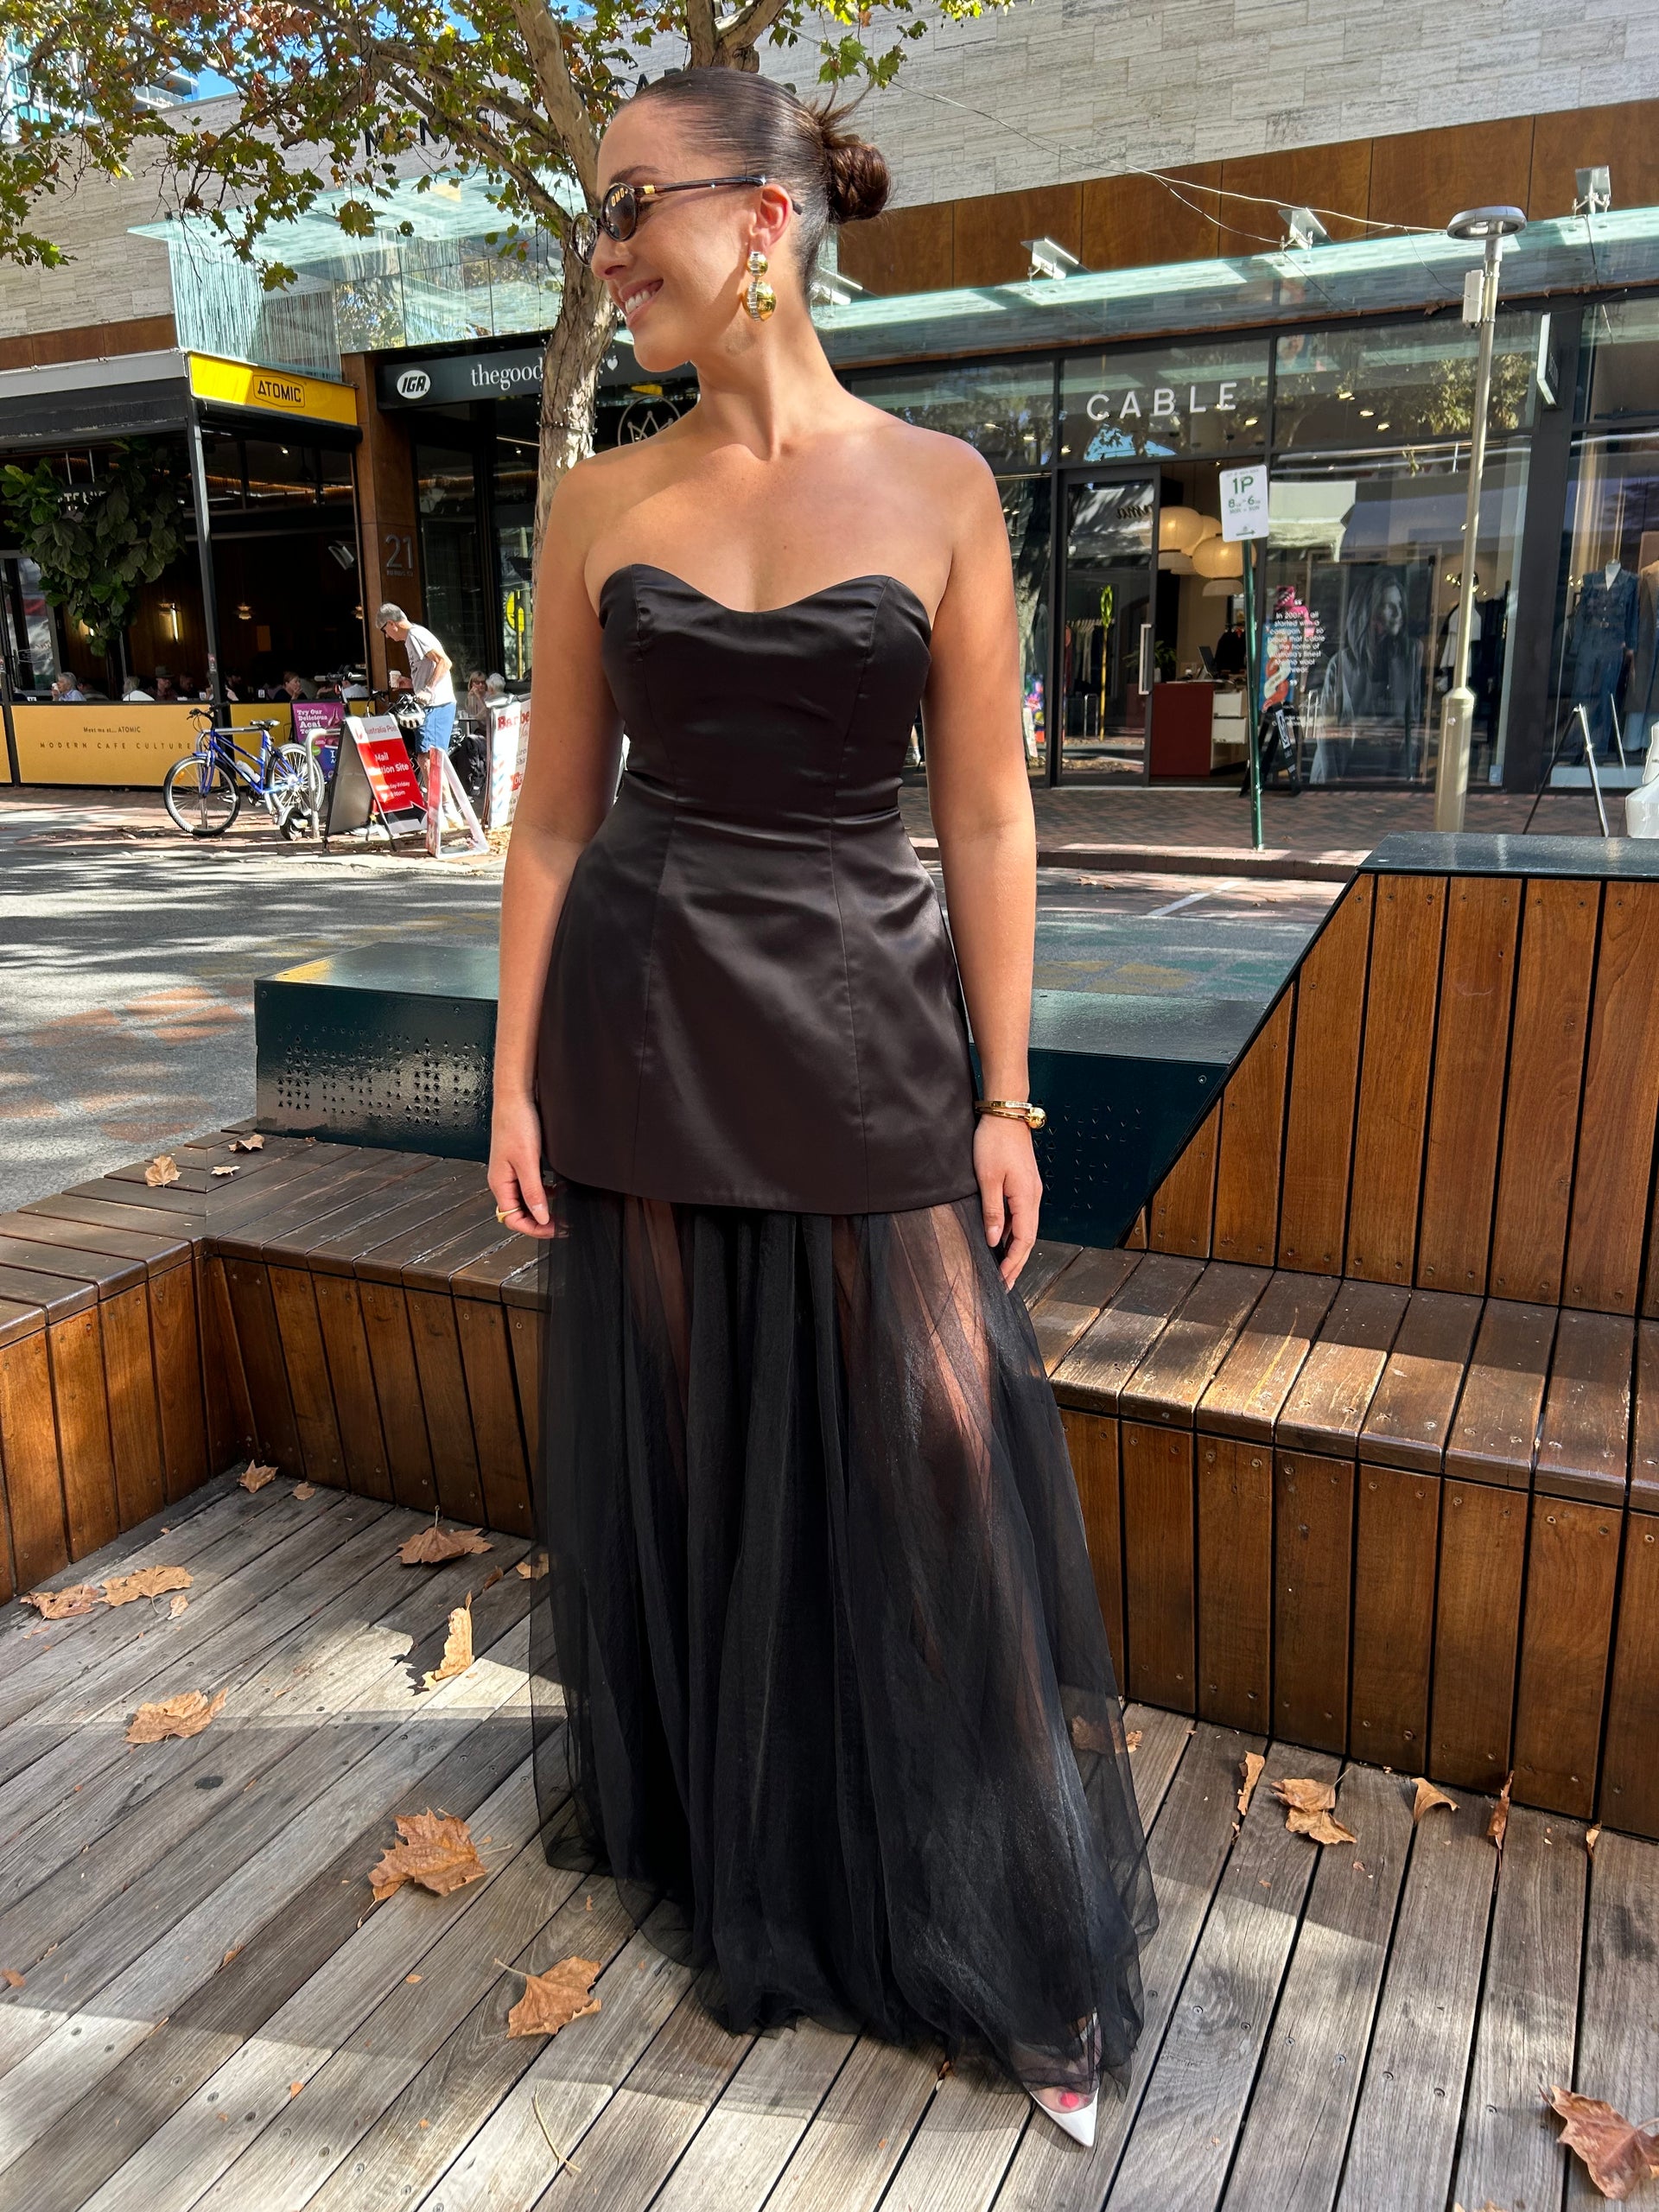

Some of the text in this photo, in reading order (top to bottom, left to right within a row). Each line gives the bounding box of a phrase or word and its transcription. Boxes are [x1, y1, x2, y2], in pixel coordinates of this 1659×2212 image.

[257, 379, 302, 404] ATOMIC
[1086, 381, 1238, 421] CABLE
[1233, 476, 1254, 494] 1P
[385, 534, 413, 569] 21
[40, 741, 87, 750] MODERN
[136, 741, 192, 750] CULTURE
[394, 762, 410, 772] Site
